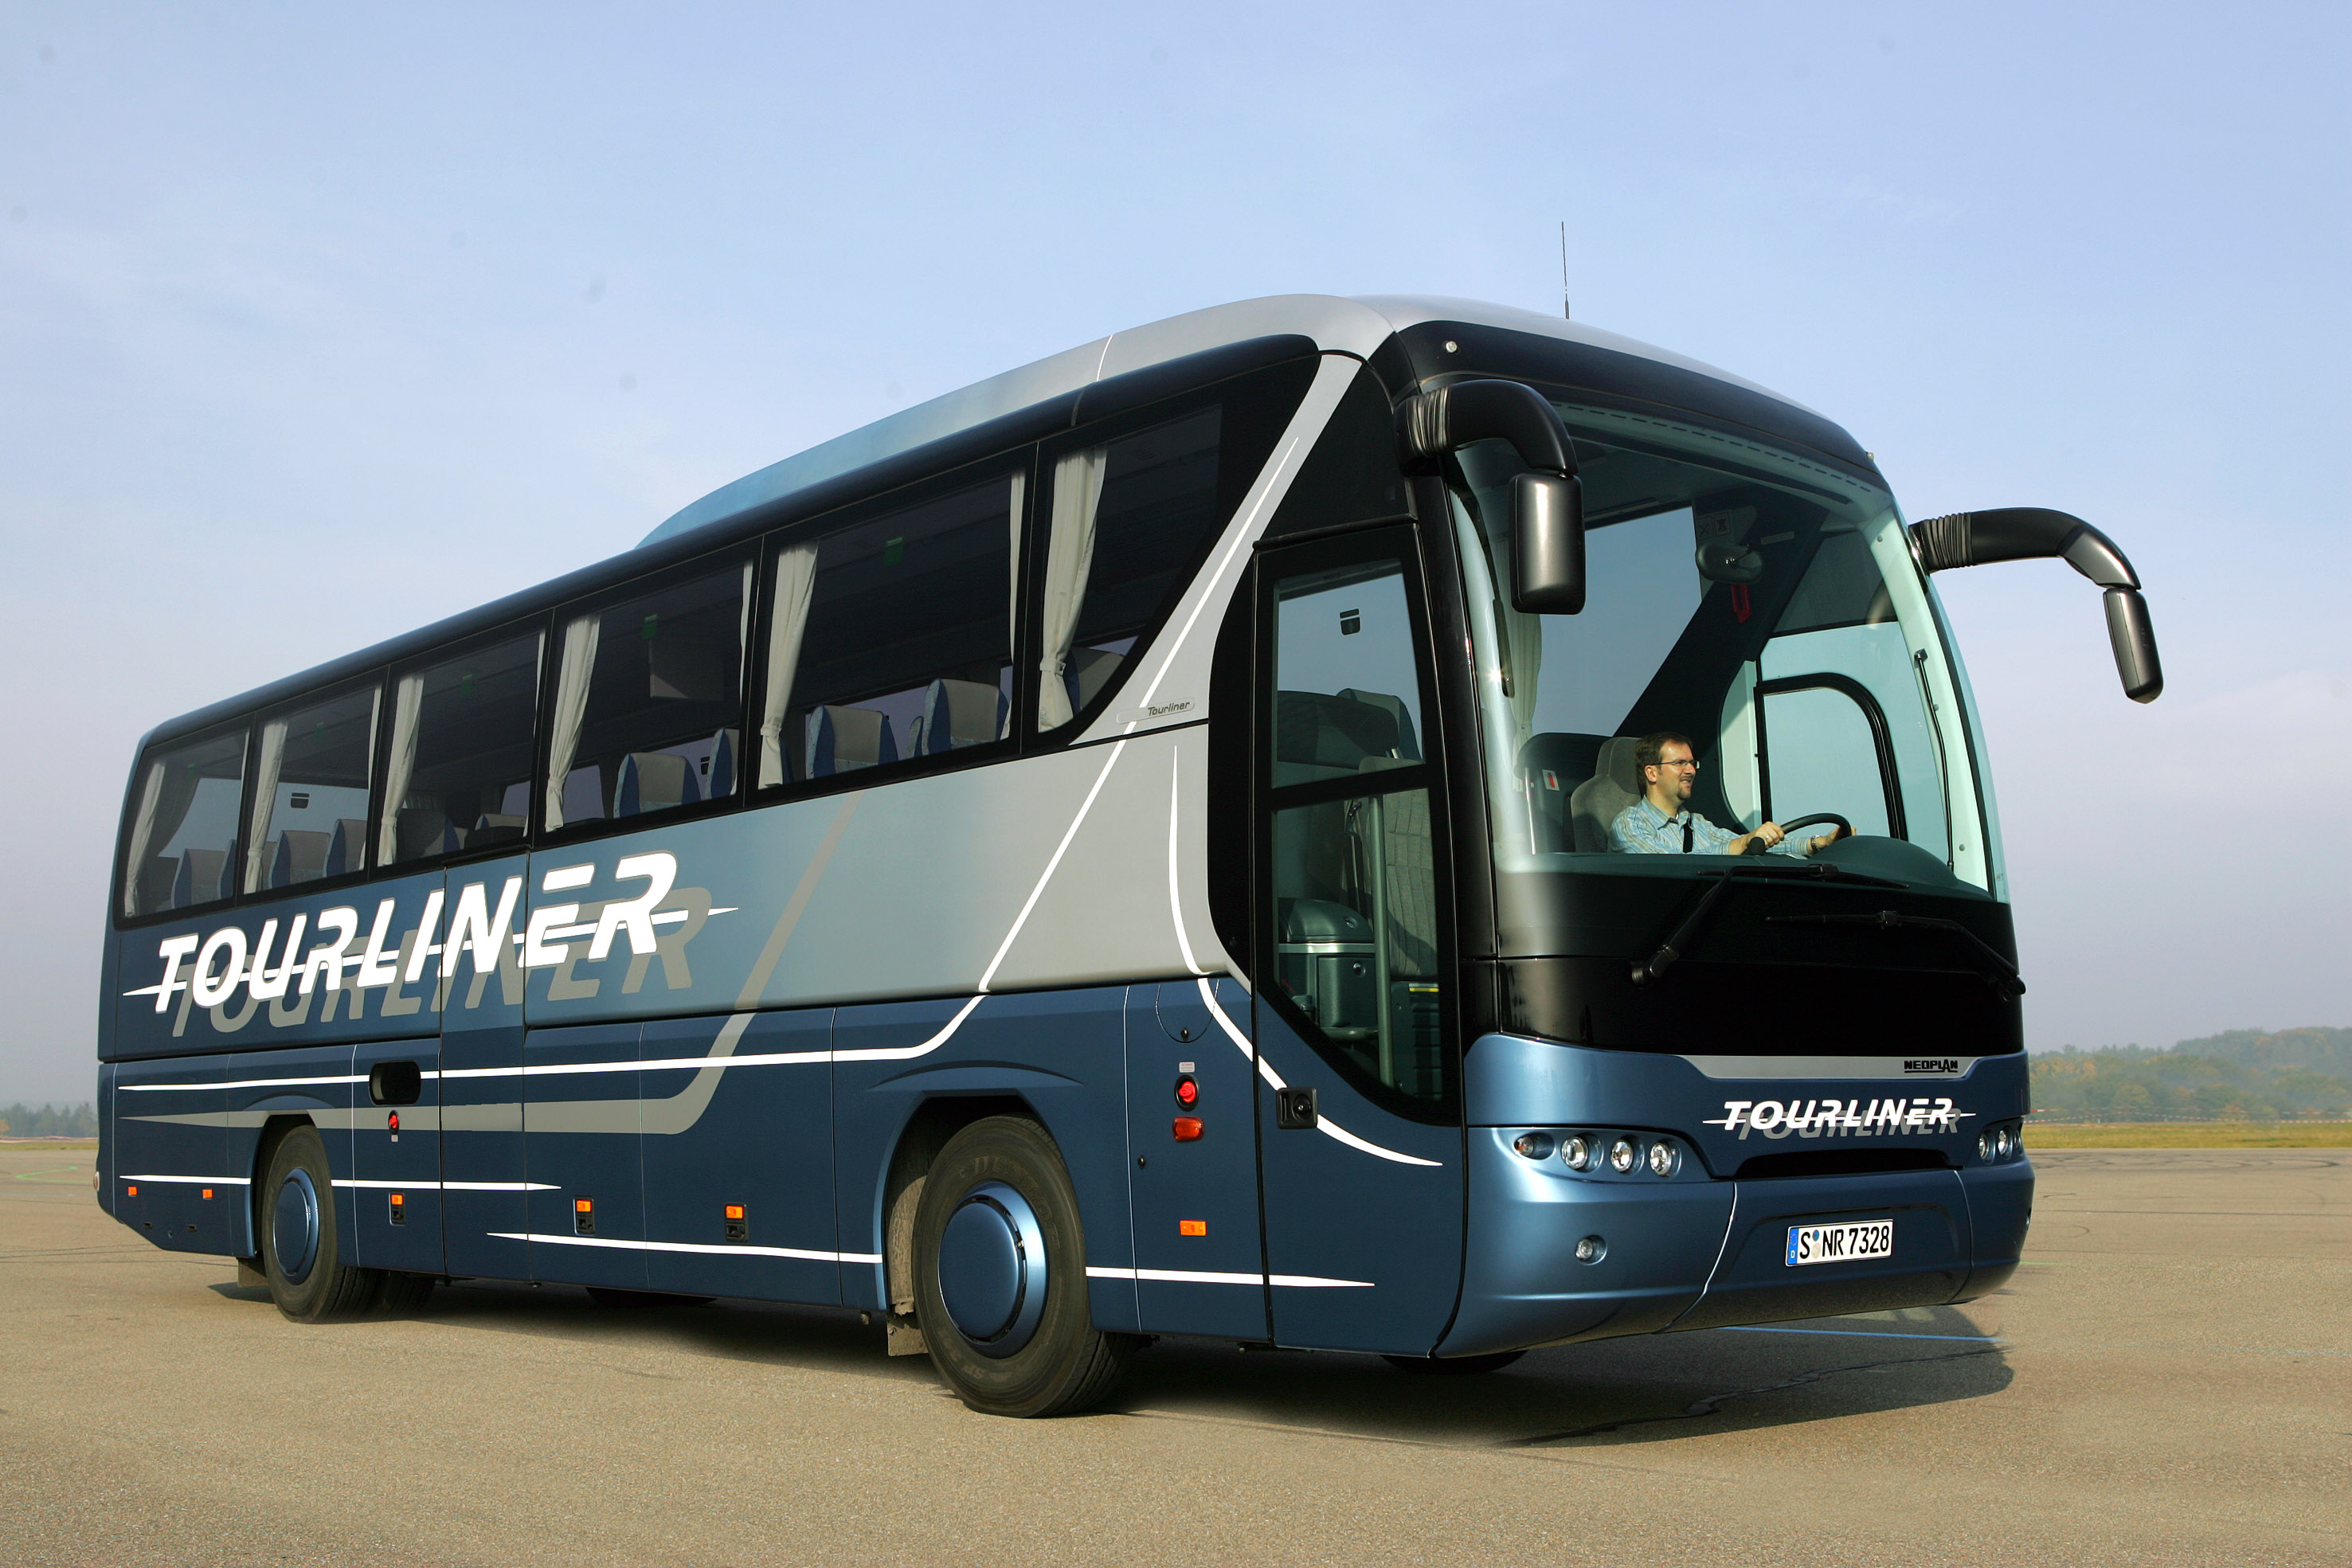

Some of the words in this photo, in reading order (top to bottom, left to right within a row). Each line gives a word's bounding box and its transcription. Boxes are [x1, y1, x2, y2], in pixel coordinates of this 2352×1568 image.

[1148, 702, 1190, 716] Tourliner
[155, 850, 679, 1014] TOURLINER
[1904, 1059, 1958, 1073] NEOPLAN
[1724, 1097, 1953, 1131] TOURLINER
[1799, 1231, 1810, 1259] S
[1822, 1229, 1843, 1257] NR
[1849, 1225, 1889, 1254] 7328
